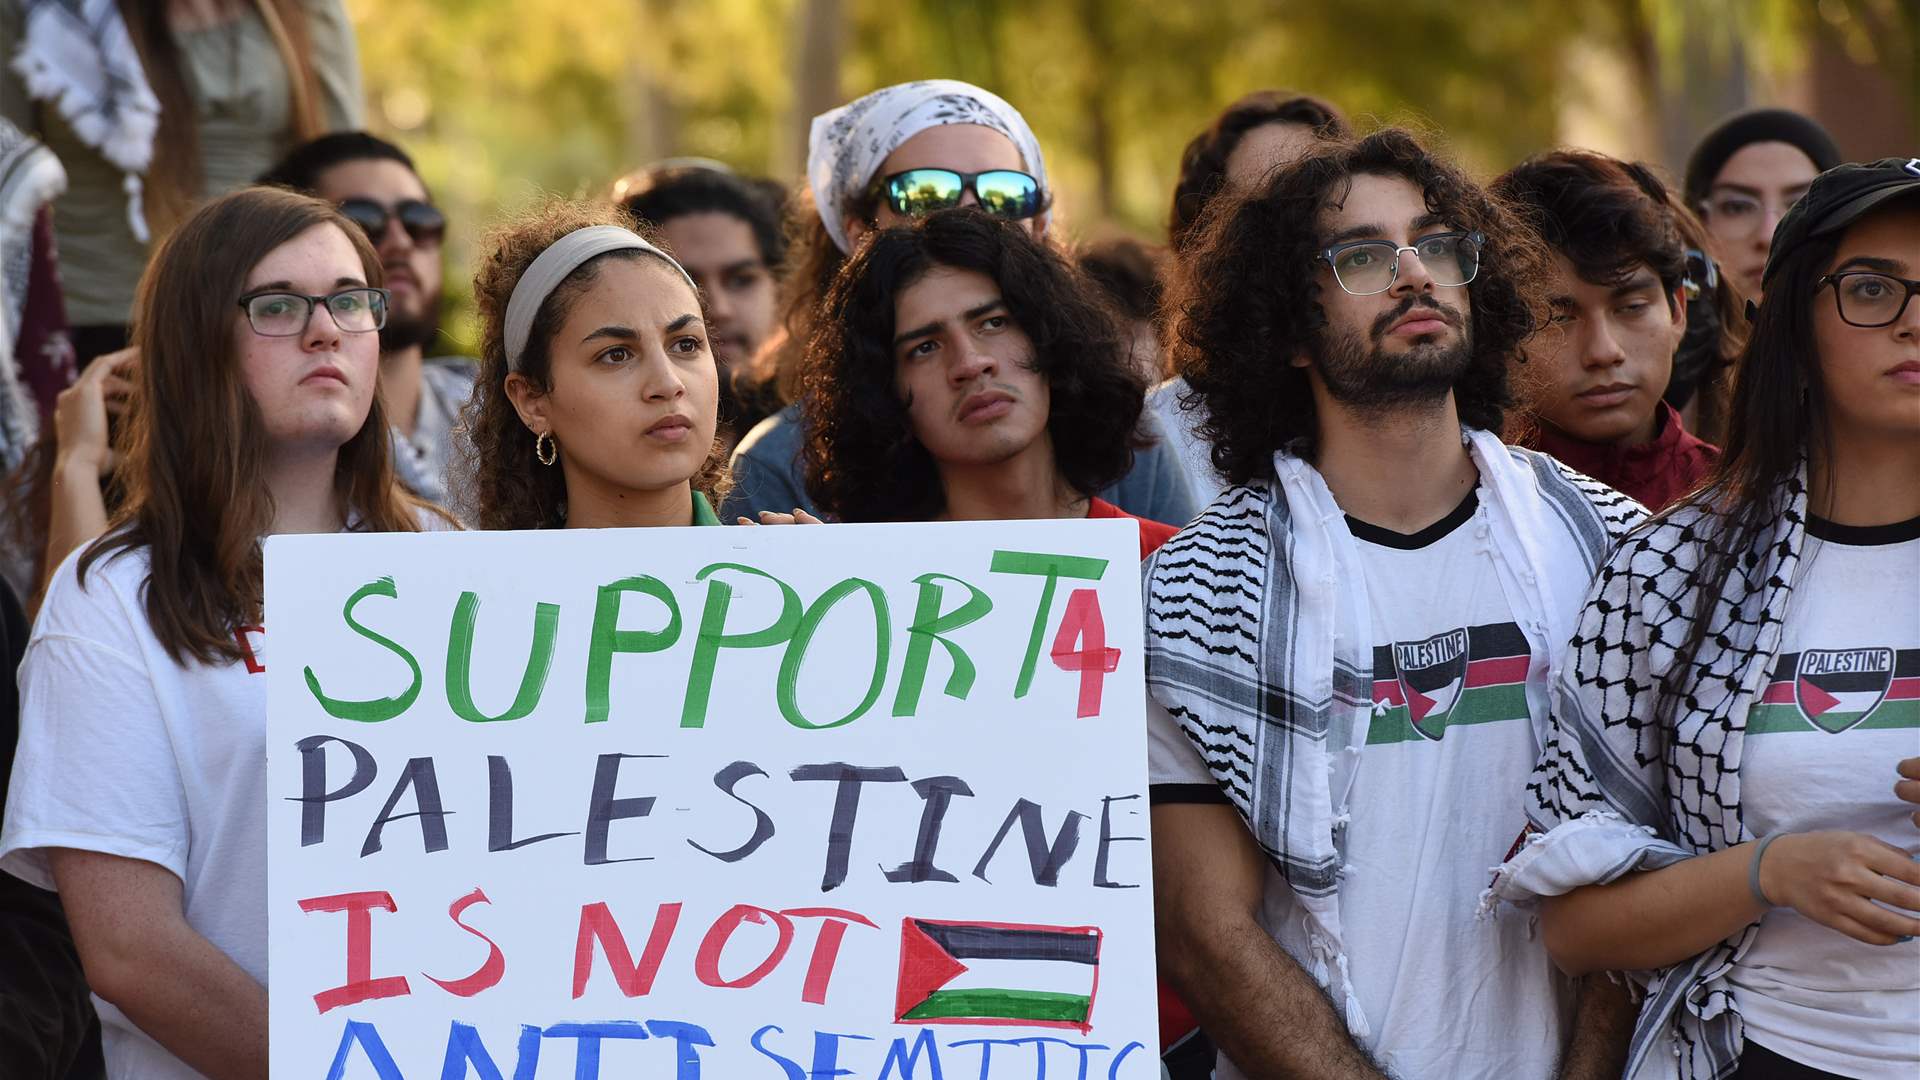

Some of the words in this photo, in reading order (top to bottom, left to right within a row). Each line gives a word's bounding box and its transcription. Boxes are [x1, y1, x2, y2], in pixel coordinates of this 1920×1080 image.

[304, 549, 1109, 730] SUPPORT
[1050, 588, 1121, 719] 4
[1805, 651, 1887, 674] PALESTINE
[284, 734, 1146, 892] PALESTINE
[297, 886, 506, 1015] IS
[572, 904, 880, 1006] NOT
